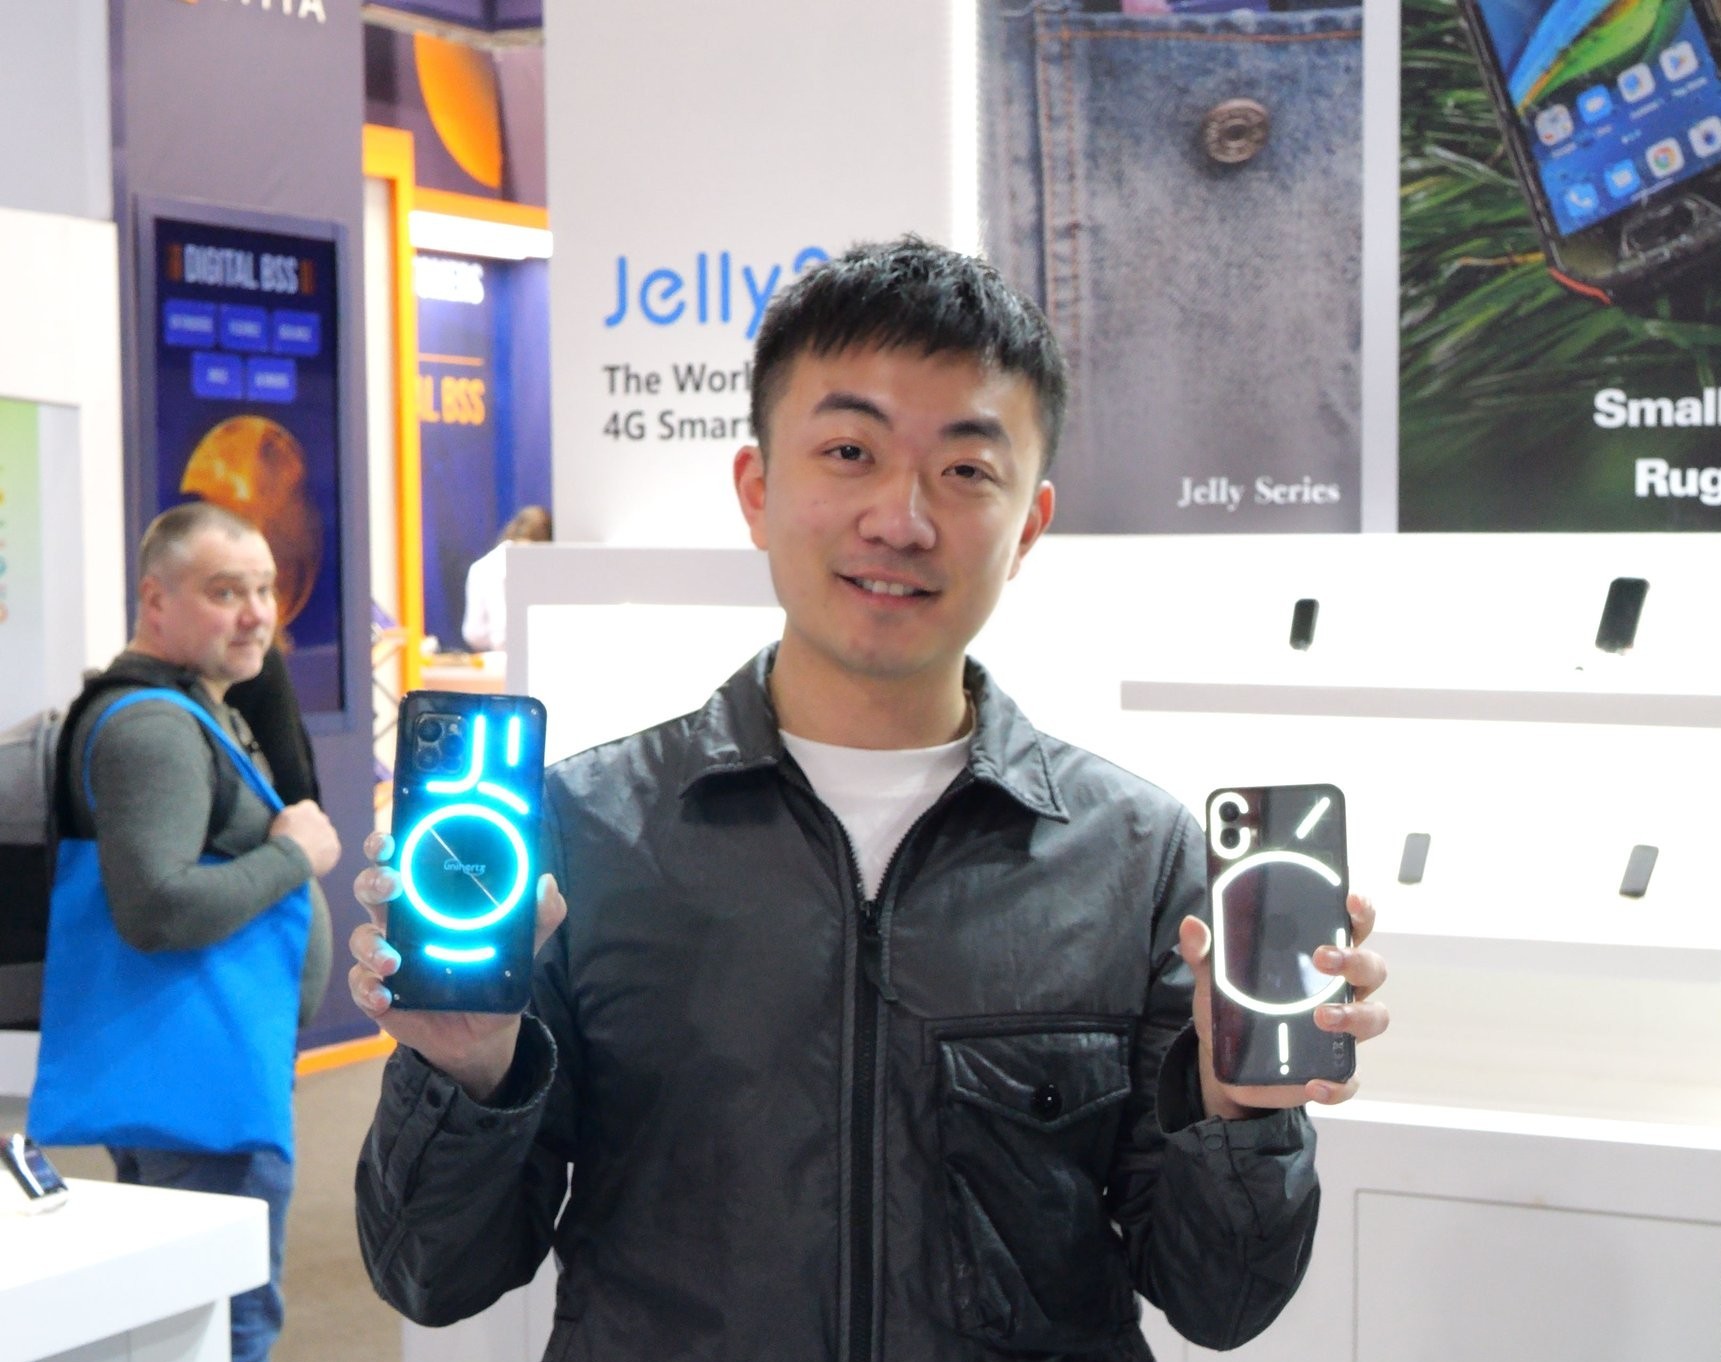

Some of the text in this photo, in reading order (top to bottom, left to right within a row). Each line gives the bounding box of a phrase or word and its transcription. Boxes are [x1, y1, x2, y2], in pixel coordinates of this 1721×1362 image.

[184, 243, 299, 294] DIGITAL BSS
[603, 360, 756, 396] The Worl
[440, 375, 486, 426] BSS
[603, 411, 646, 442] 4G
[1176, 474, 1342, 513] Jelly Series
